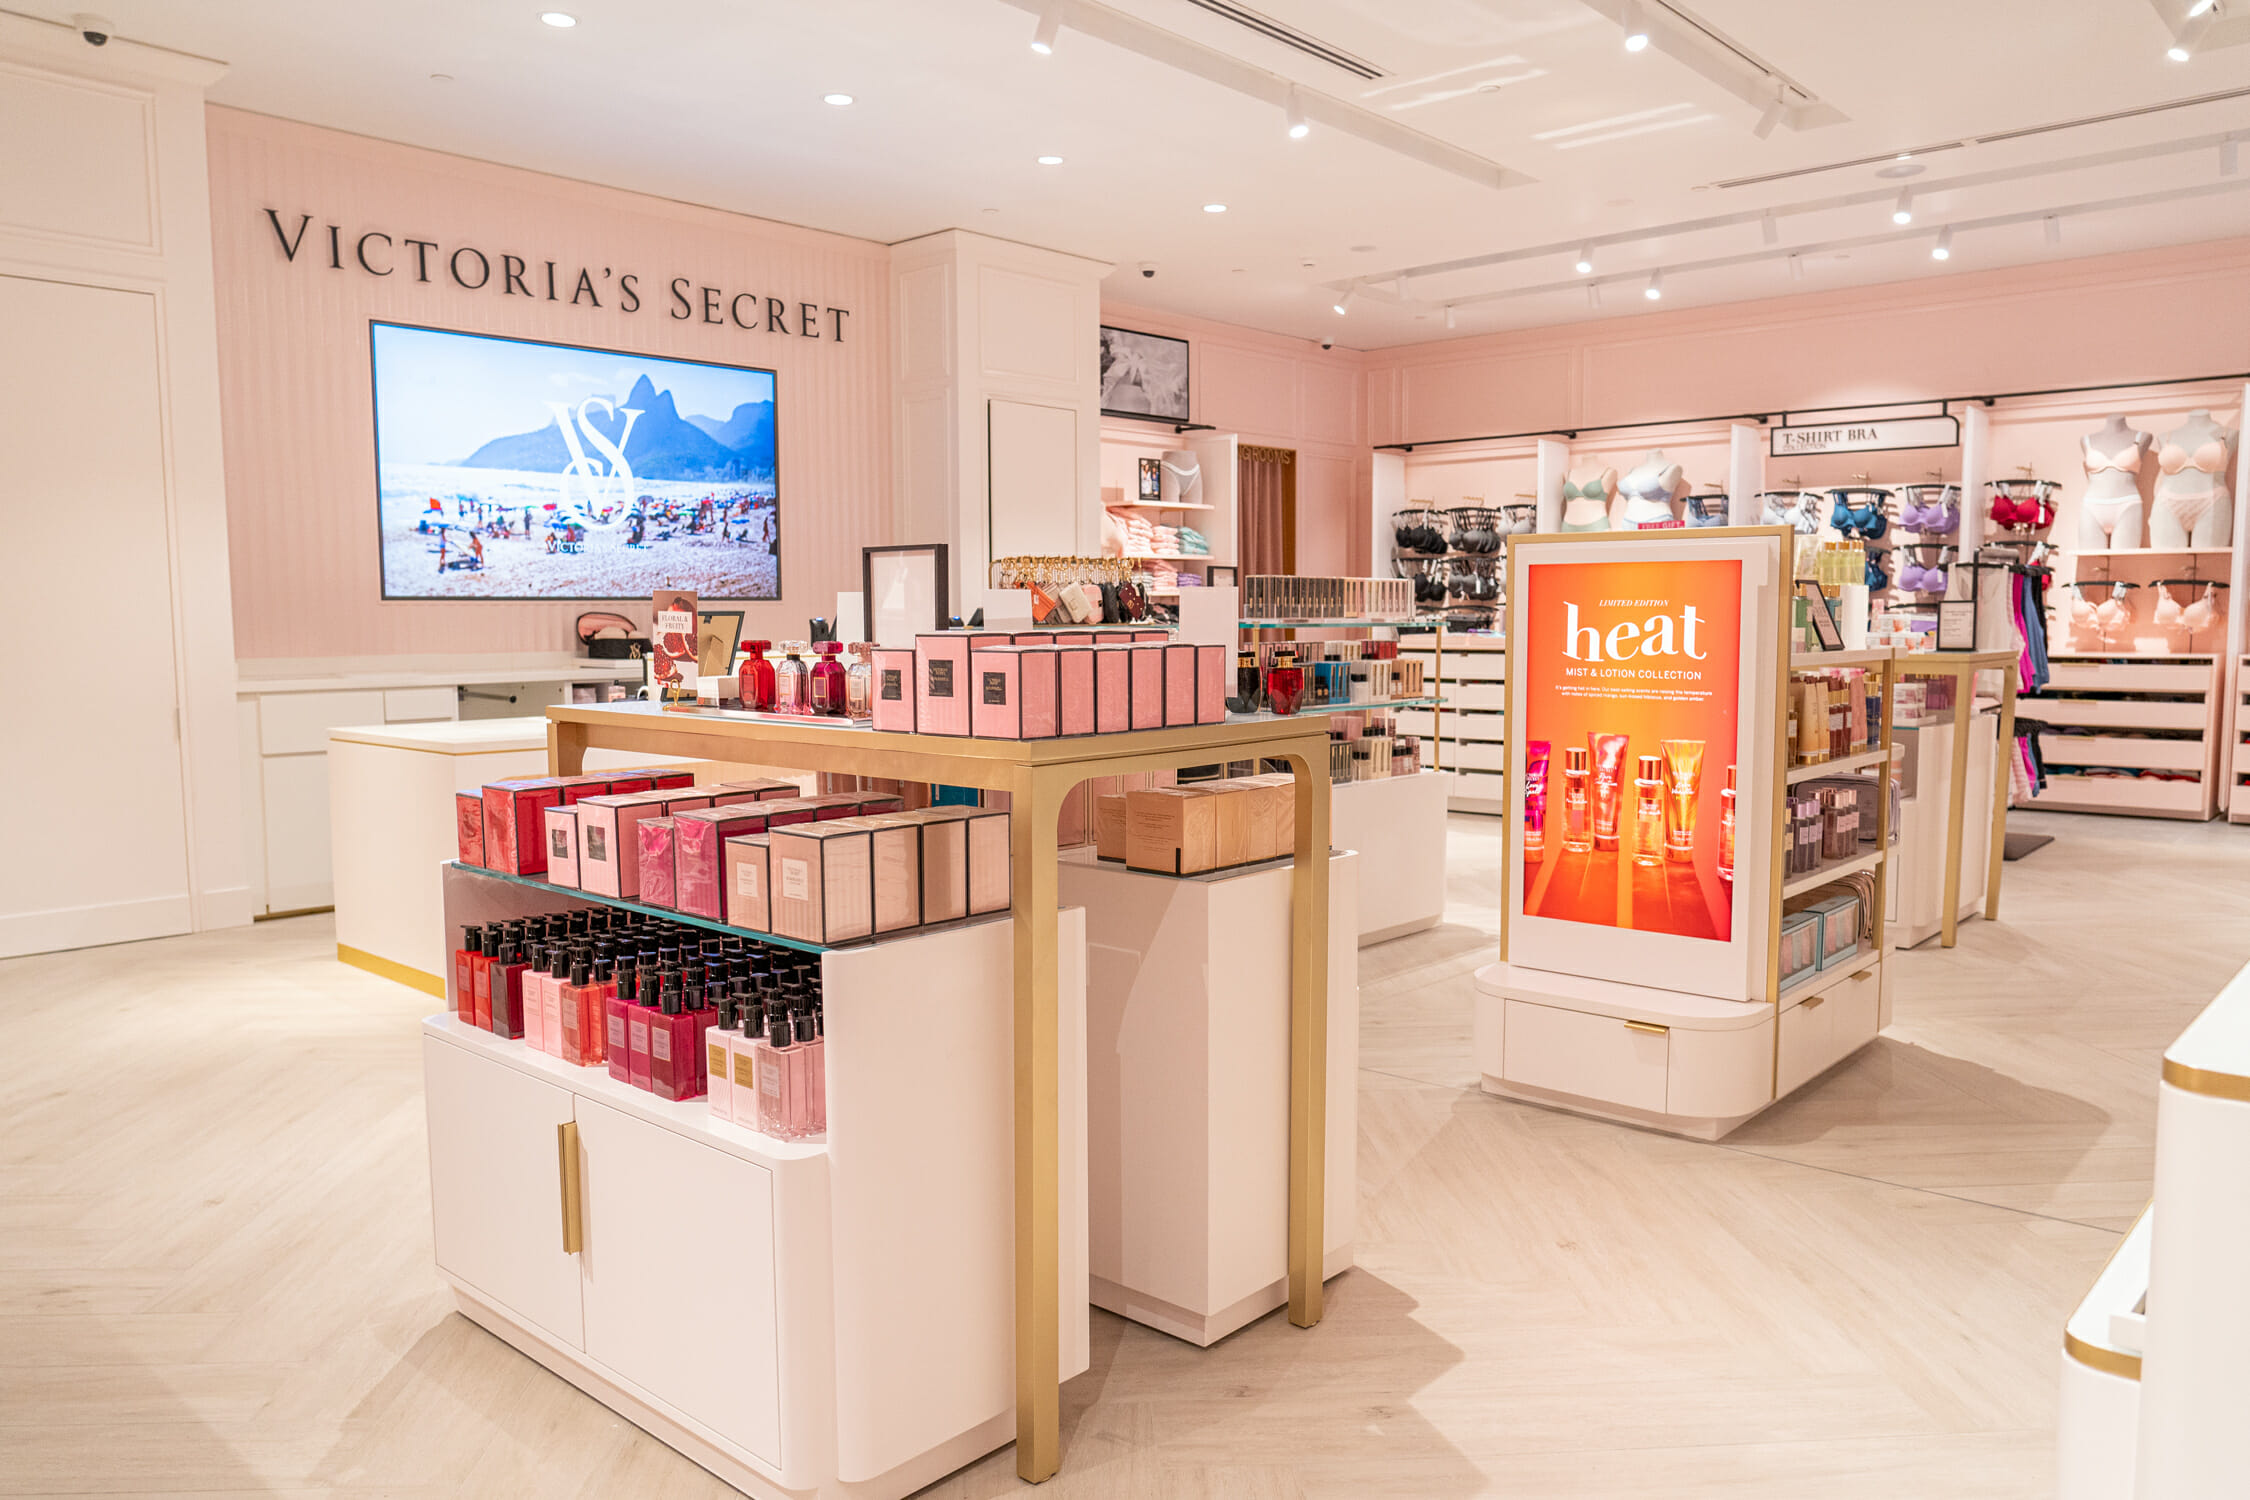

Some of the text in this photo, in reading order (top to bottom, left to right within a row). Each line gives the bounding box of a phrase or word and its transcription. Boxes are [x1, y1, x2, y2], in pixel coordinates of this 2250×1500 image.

[264, 209, 851, 343] VICTORIA'S SECRET
[1783, 428, 1877, 444] T-SHIRT BRA
[1253, 447, 1291, 464] ROOMS
[1599, 599, 1670, 607] LIMITED EDITION
[1562, 601, 1707, 662] heat
[1566, 668, 1702, 680] MIST & LOTION COLLECTION
